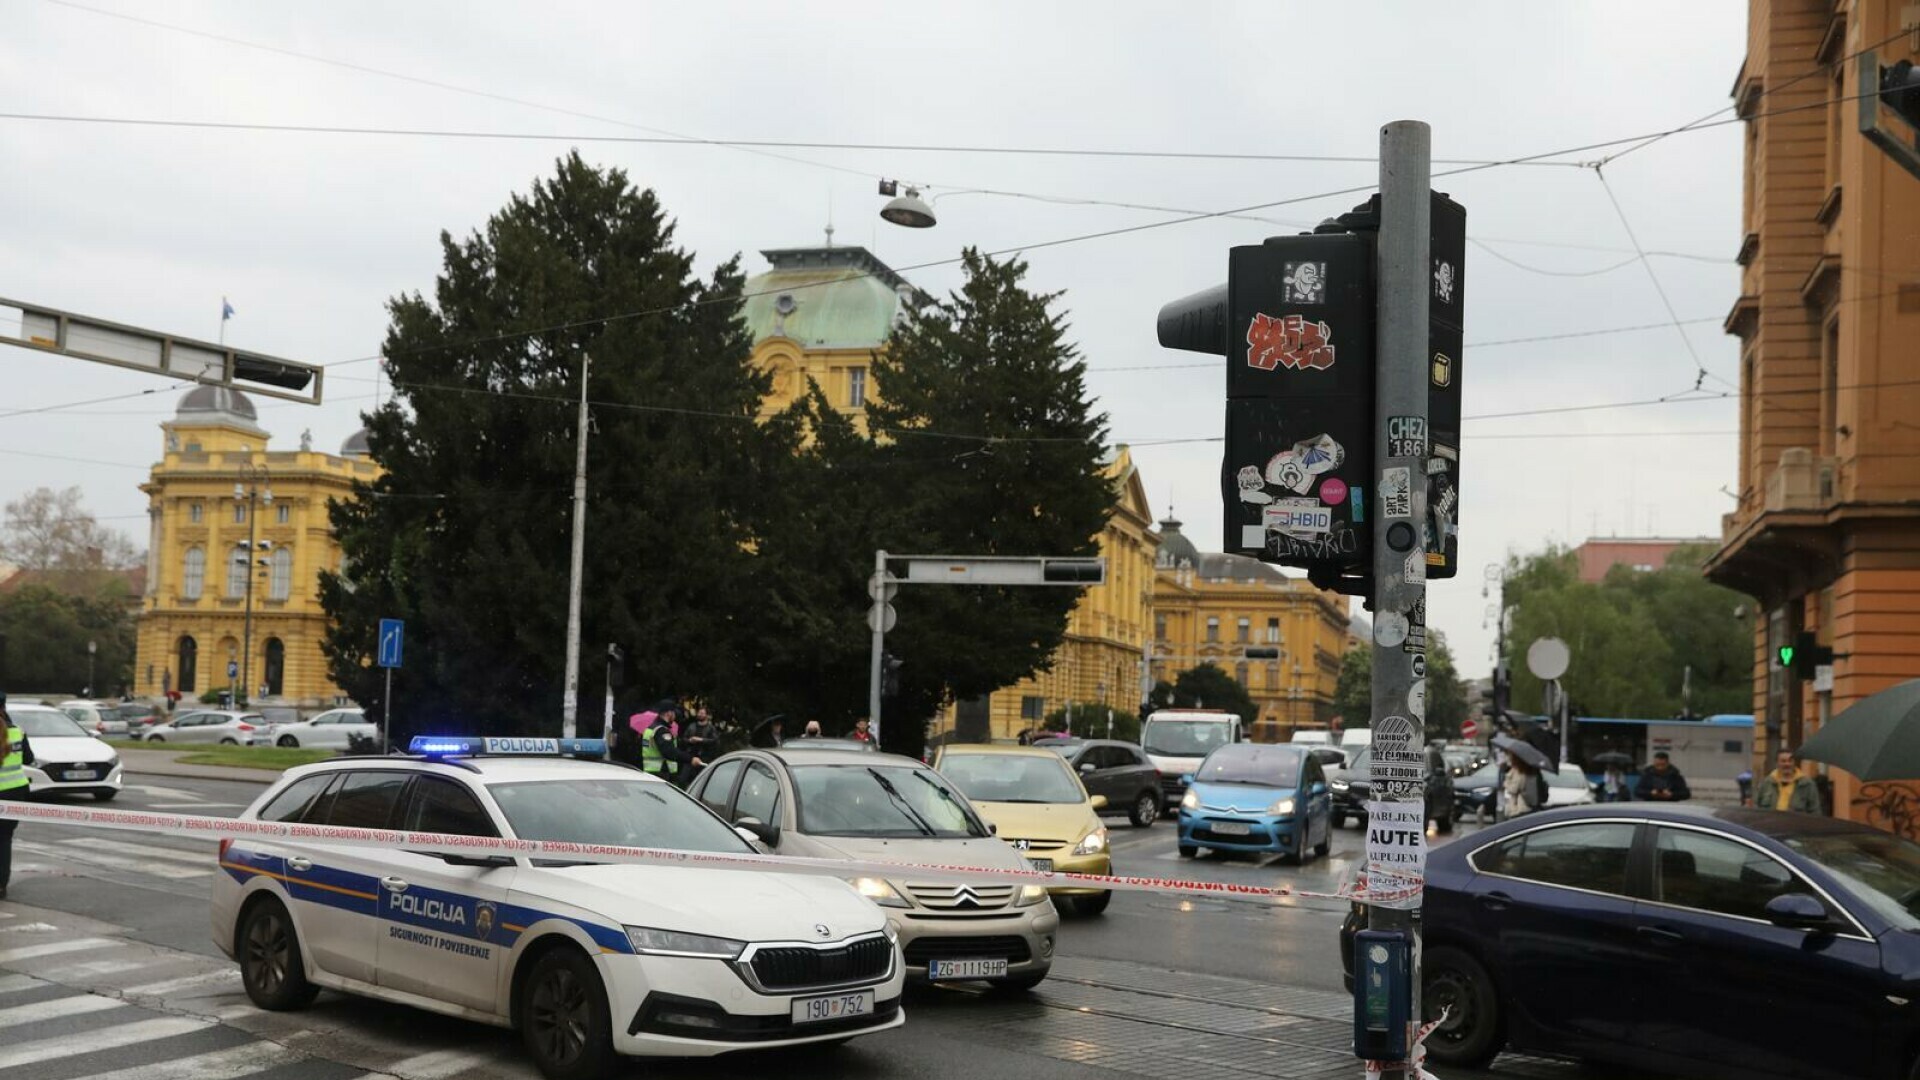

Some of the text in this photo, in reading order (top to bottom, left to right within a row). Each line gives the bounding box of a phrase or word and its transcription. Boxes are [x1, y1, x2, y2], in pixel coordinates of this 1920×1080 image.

[1390, 417, 1424, 440] CHEZ
[1394, 440, 1422, 457] 186
[1397, 486, 1409, 515] PARK
[490, 739, 554, 752] POLICIJA
[1370, 829, 1419, 846] AUTE
[390, 893, 466, 925] POLICIJA
[389, 926, 432, 948] SIGURNOST
[440, 938, 491, 960] POVJERENJE
[939, 961, 954, 976] ZG
[806, 995, 864, 1019] 190 752
